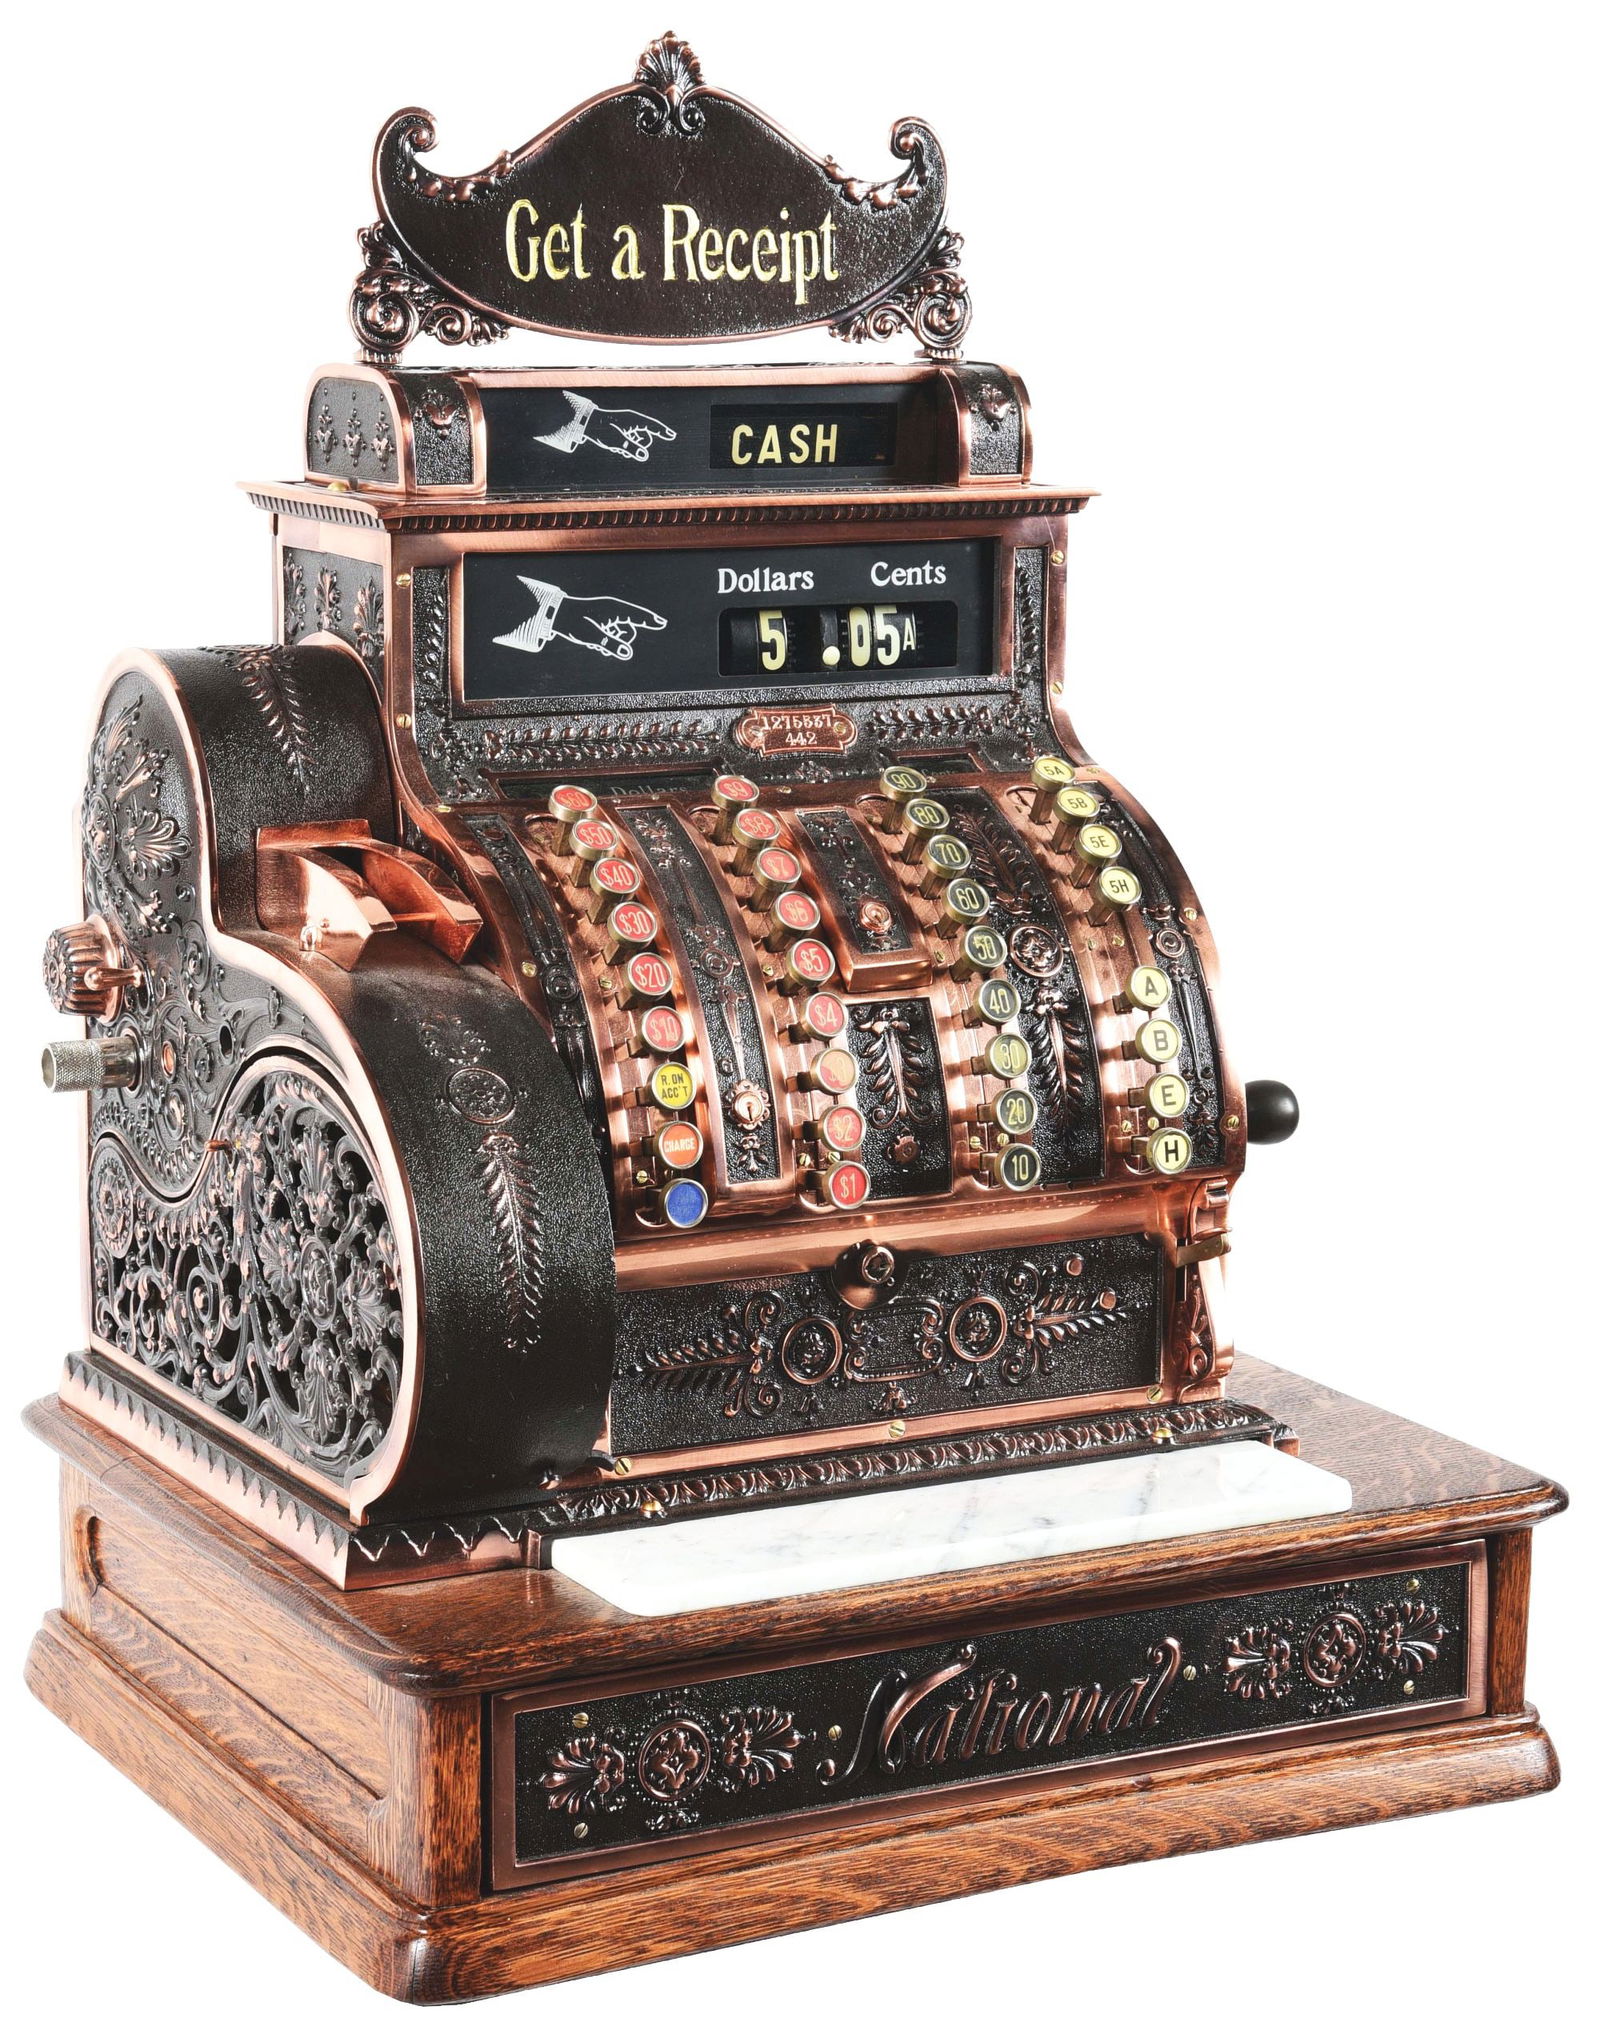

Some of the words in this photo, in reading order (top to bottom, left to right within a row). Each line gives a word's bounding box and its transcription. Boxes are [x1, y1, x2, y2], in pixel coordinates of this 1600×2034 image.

[505, 199, 591, 282] Get
[611, 225, 646, 281] a
[662, 204, 839, 305] Receipt
[731, 424, 838, 465] CASH
[717, 567, 815, 594] Dollars
[871, 560, 947, 587] Cents
[759, 609, 787, 671] 5
[785, 731, 818, 746] 442
[891, 772, 917, 789] 90
[1043, 764, 1064, 777] 5A
[724, 781, 748, 797] $9
[914, 805, 938, 825] 80
[1067, 797, 1088, 809] 5B
[580, 826, 612, 845] $50
[744, 816, 768, 833] $8
[935, 842, 960, 865] 70
[1089, 834, 1110, 849] 5E
[600, 864, 632, 887] $40
[766, 856, 789, 876] $7
[1109, 878, 1129, 894] 5H
[955, 886, 979, 911] 60
[619, 911, 650, 935] $30
[785, 900, 808, 922] $6
[972, 934, 998, 960] 50
[800, 947, 824, 973] $5
[635, 962, 667, 988] $20
[1144, 975, 1159, 997] A
[989, 989, 1011, 1014] 40
[815, 1003, 837, 1027] $4
[650, 1015, 679, 1042] $10
[1153, 1029, 1169, 1051] B
[999, 1042, 1020, 1072] 30
[1161, 1084, 1176, 1107] E
[1006, 1097, 1027, 1125] 20
[832, 1114, 852, 1141] $2
[663, 1137, 696, 1153] CHARGE
[1163, 1139, 1180, 1163] H
[1012, 1153, 1030, 1181] 10
[840, 1170, 857, 1199] $1
[815, 1635, 1182, 1786] National
